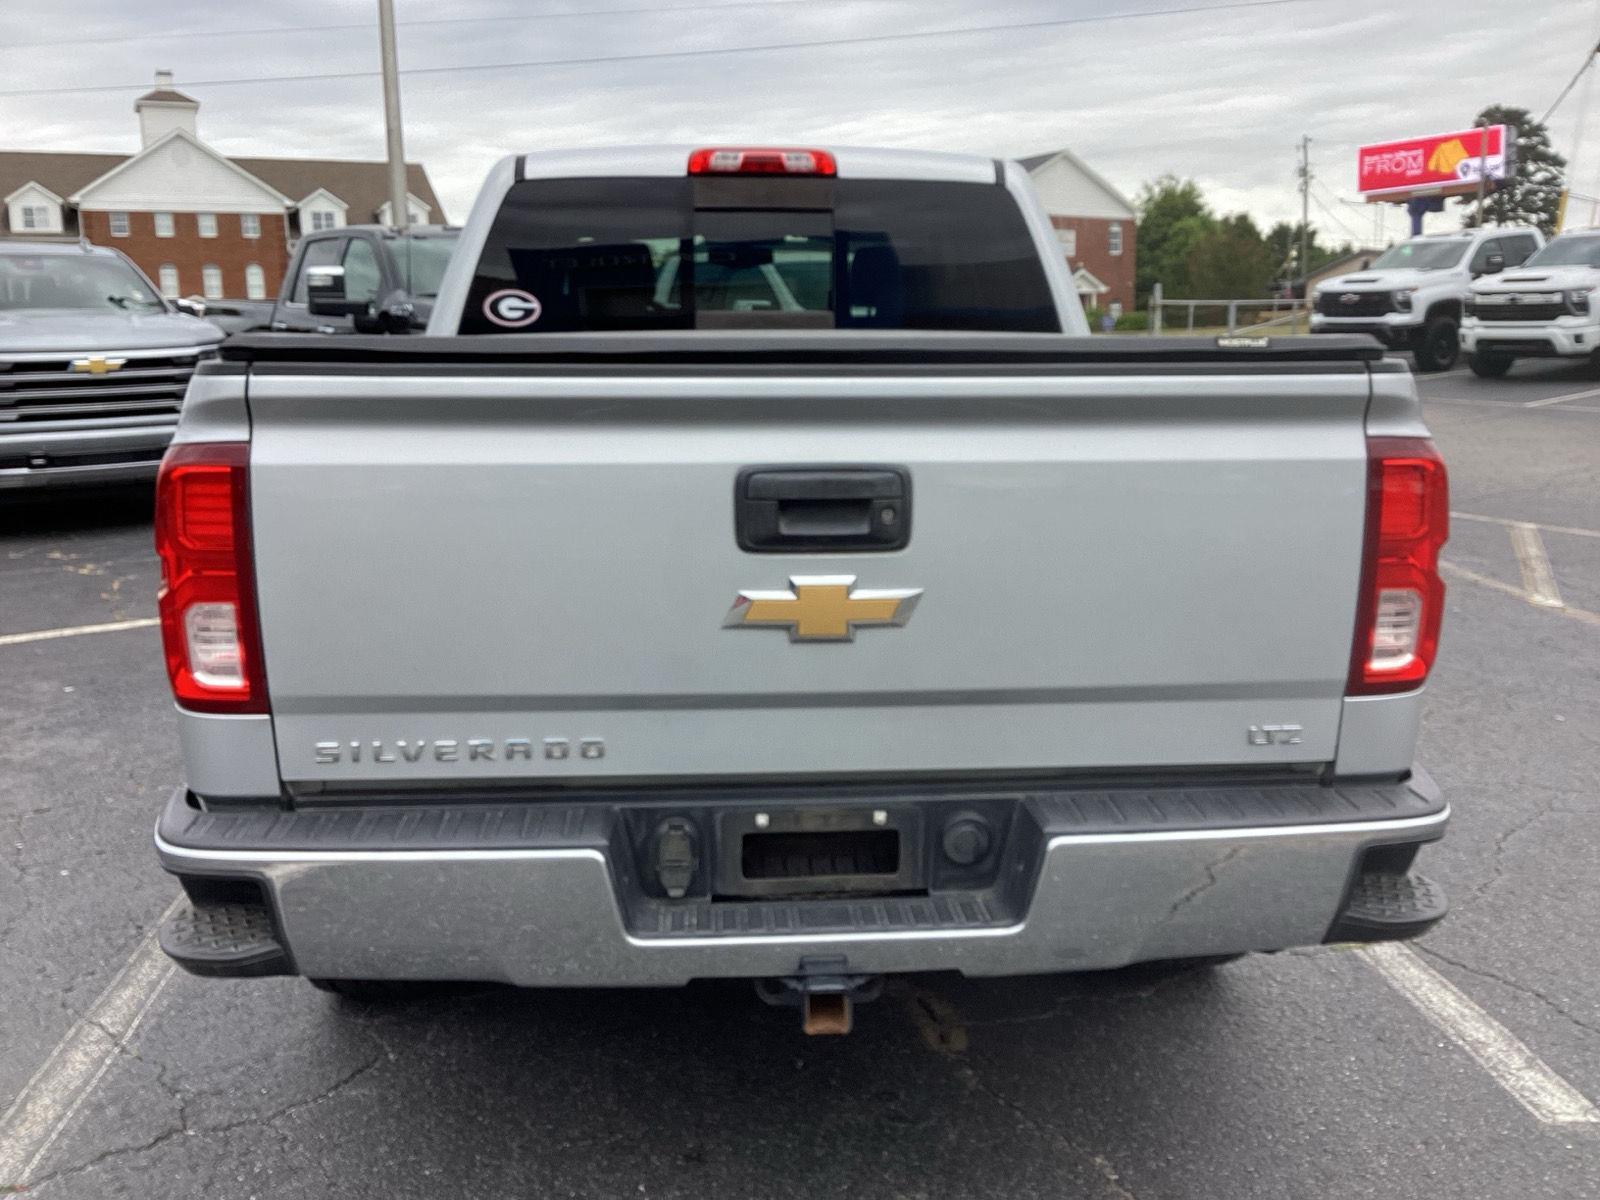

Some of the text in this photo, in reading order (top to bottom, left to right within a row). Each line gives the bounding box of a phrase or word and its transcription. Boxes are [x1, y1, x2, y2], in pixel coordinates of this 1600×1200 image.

[495, 295, 540, 321] G
[1247, 724, 1303, 746] LTZ
[315, 737, 606, 763] SILVERADO
